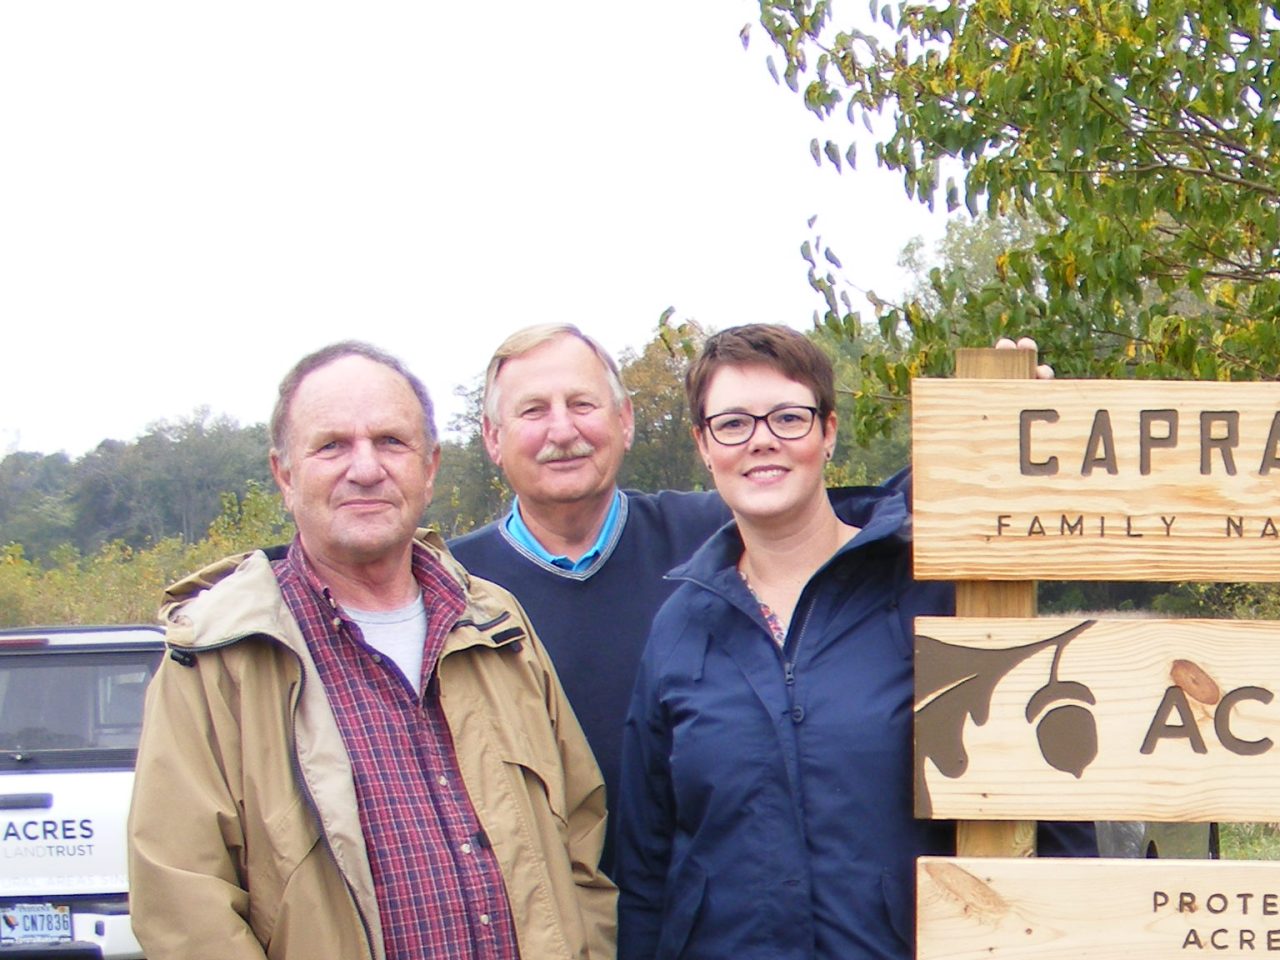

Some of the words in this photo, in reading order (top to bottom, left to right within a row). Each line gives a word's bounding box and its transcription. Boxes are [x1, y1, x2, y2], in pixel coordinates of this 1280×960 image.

[997, 514, 1177, 538] FAMILY
[3, 819, 94, 841] ACRES
[23, 914, 69, 931] CN7836
